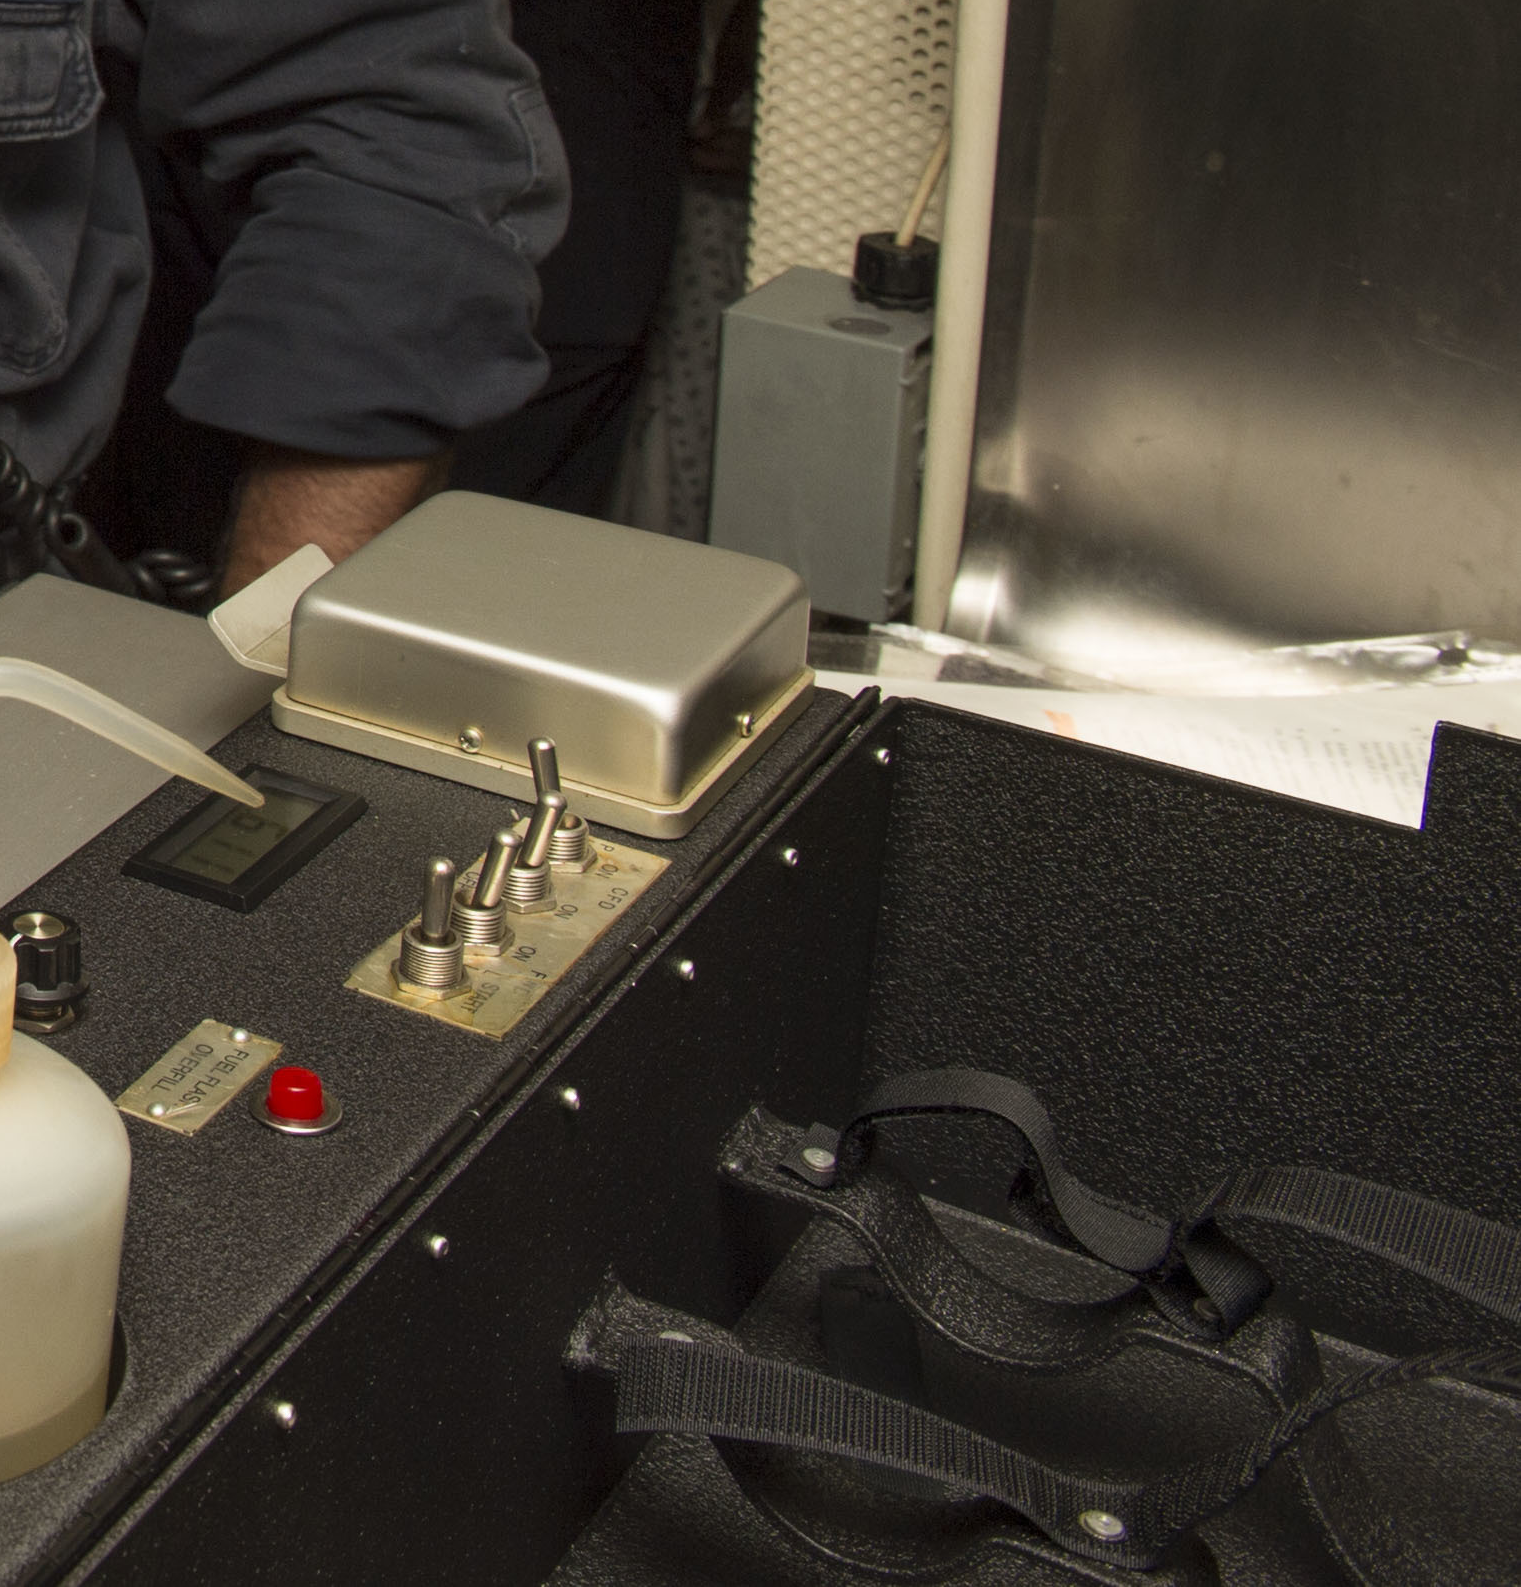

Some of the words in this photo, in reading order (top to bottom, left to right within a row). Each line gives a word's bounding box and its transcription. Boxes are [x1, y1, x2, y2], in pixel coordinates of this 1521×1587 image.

[595, 864, 619, 880] ON
[598, 886, 629, 910] CFD
[553, 903, 578, 920] ON
[511, 944, 537, 963] ON
[460, 981, 500, 1015] START
[151, 1042, 214, 1092] OVERFILL
[208, 1048, 250, 1075] FUEL
